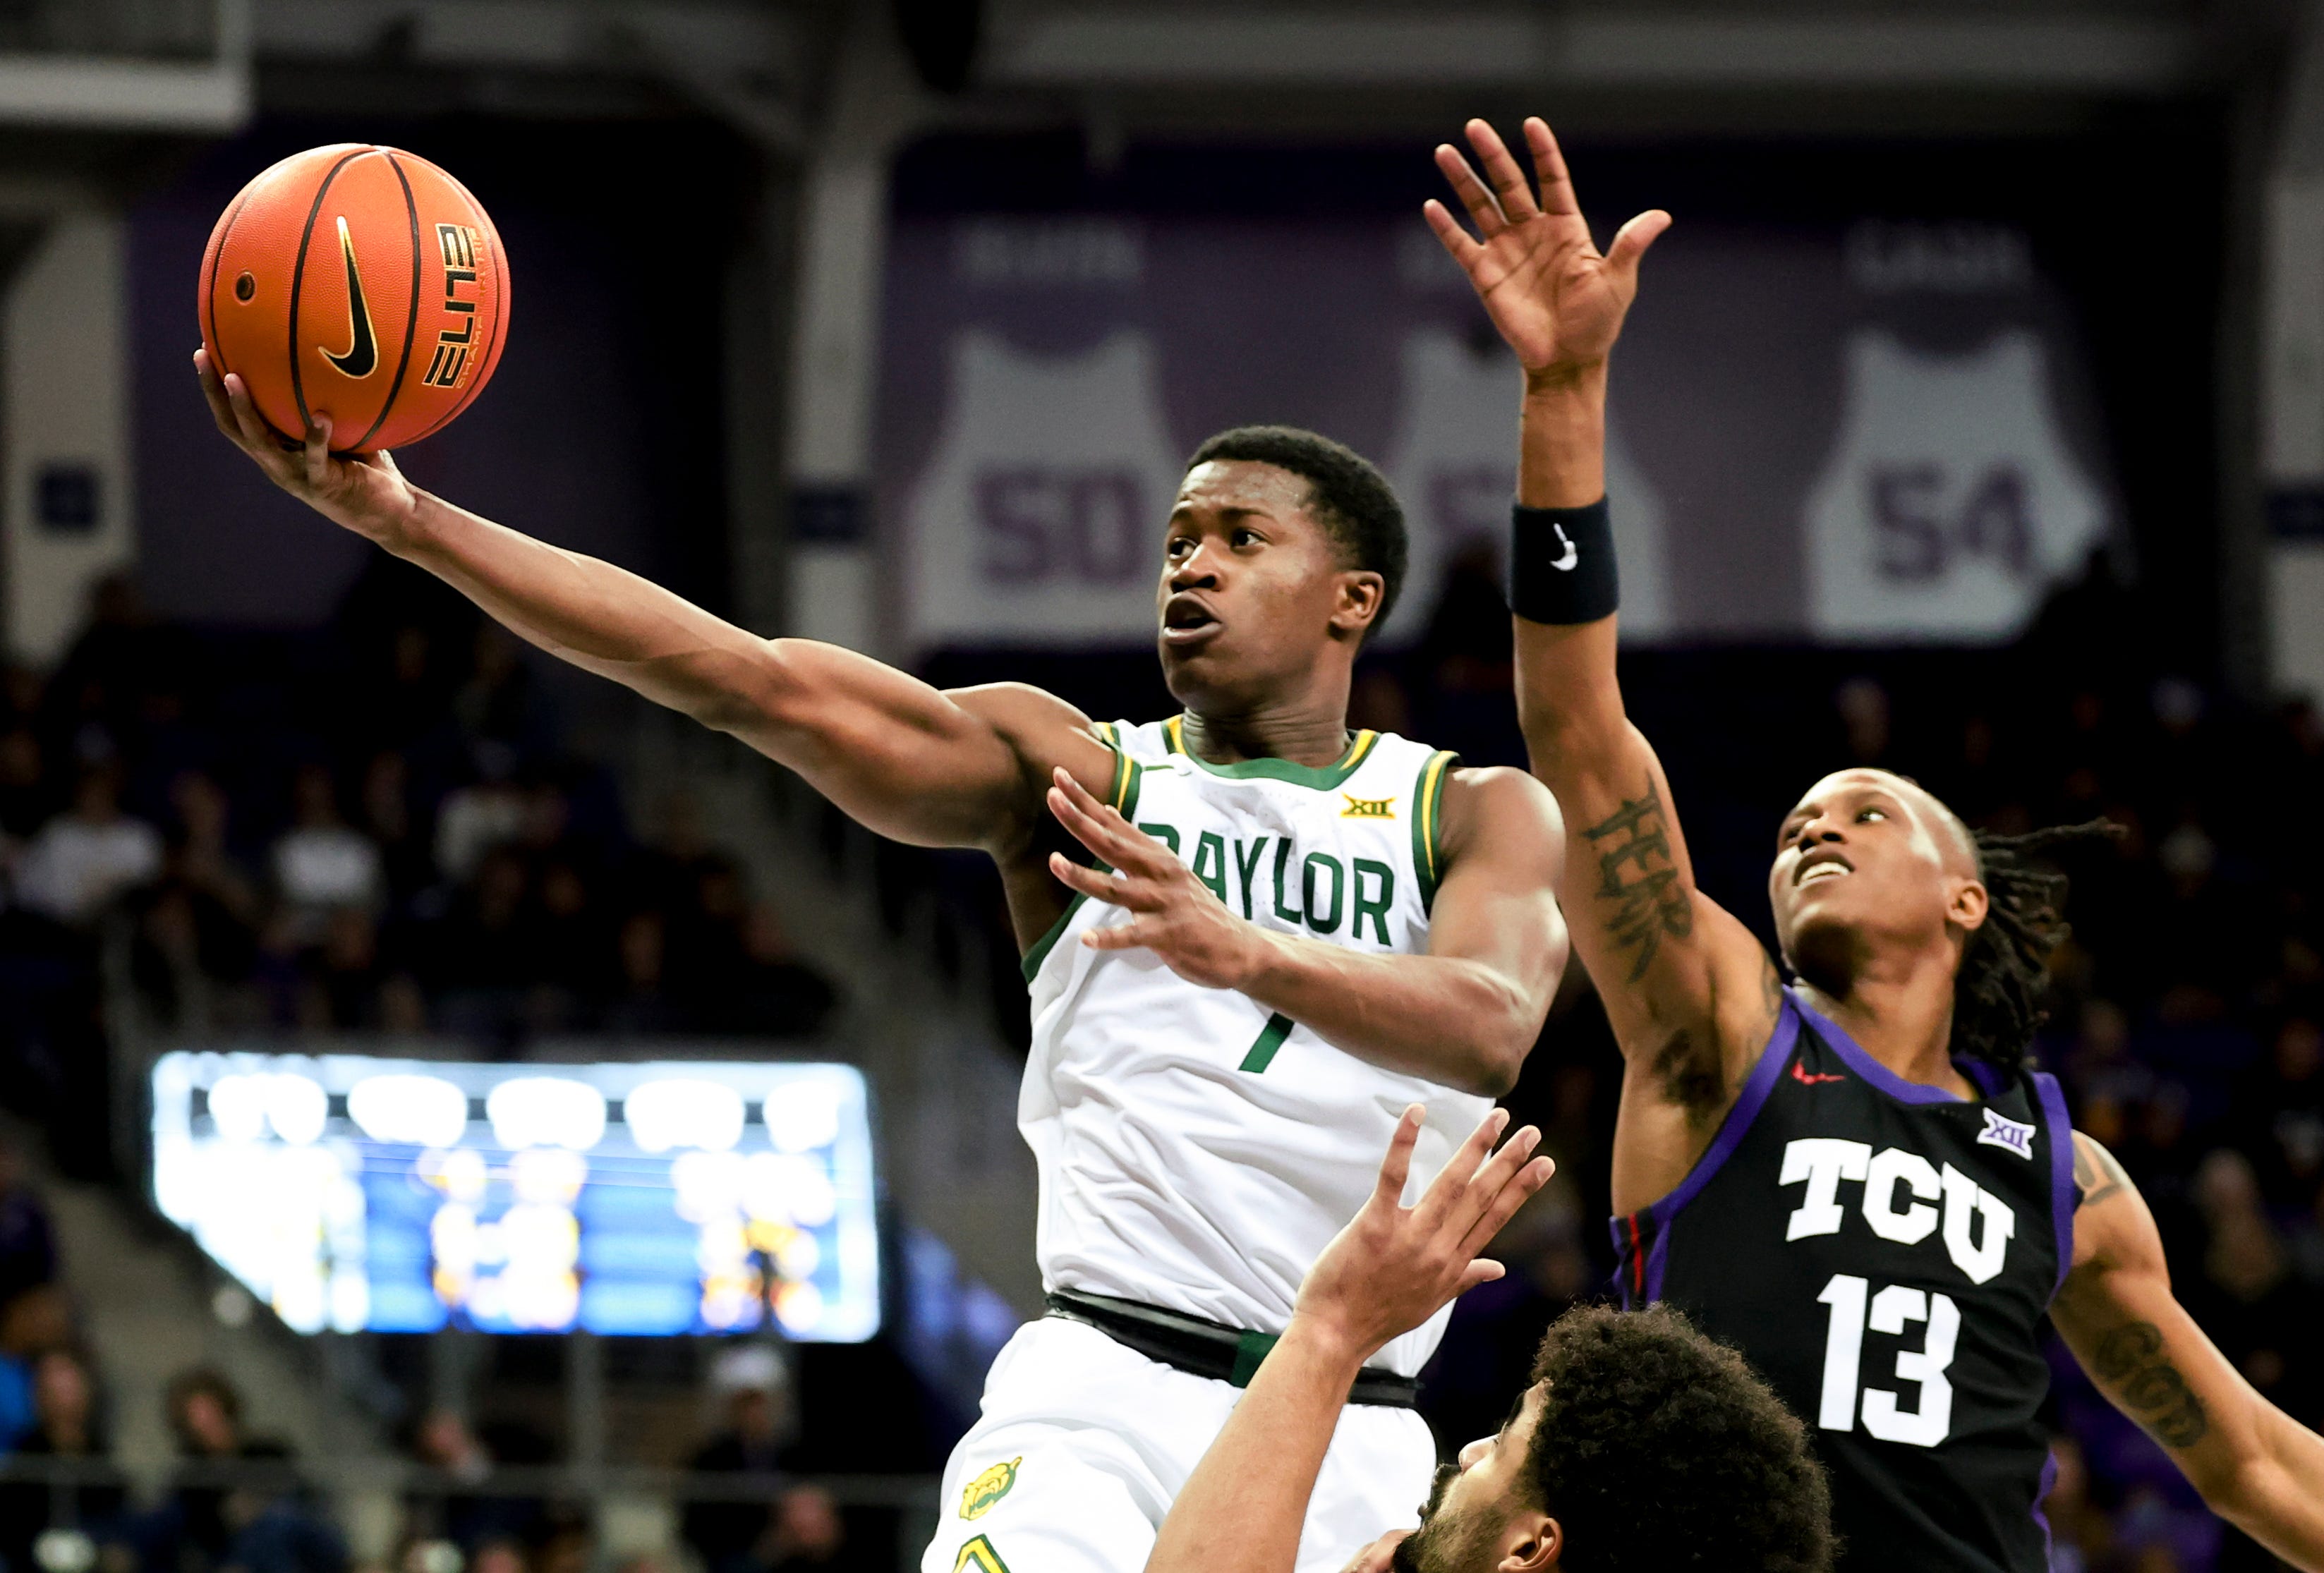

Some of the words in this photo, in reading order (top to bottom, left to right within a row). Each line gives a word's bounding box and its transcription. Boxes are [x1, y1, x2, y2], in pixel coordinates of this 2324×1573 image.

[422, 223, 477, 388] ELITE
[976, 466, 1147, 590] 50
[1870, 458, 2035, 593] 54
[1343, 794, 1396, 818] XII
[1983, 1112, 2030, 1154] XII
[1779, 1138, 2015, 1284] TCU
[1817, 1274, 1961, 1447] 13
